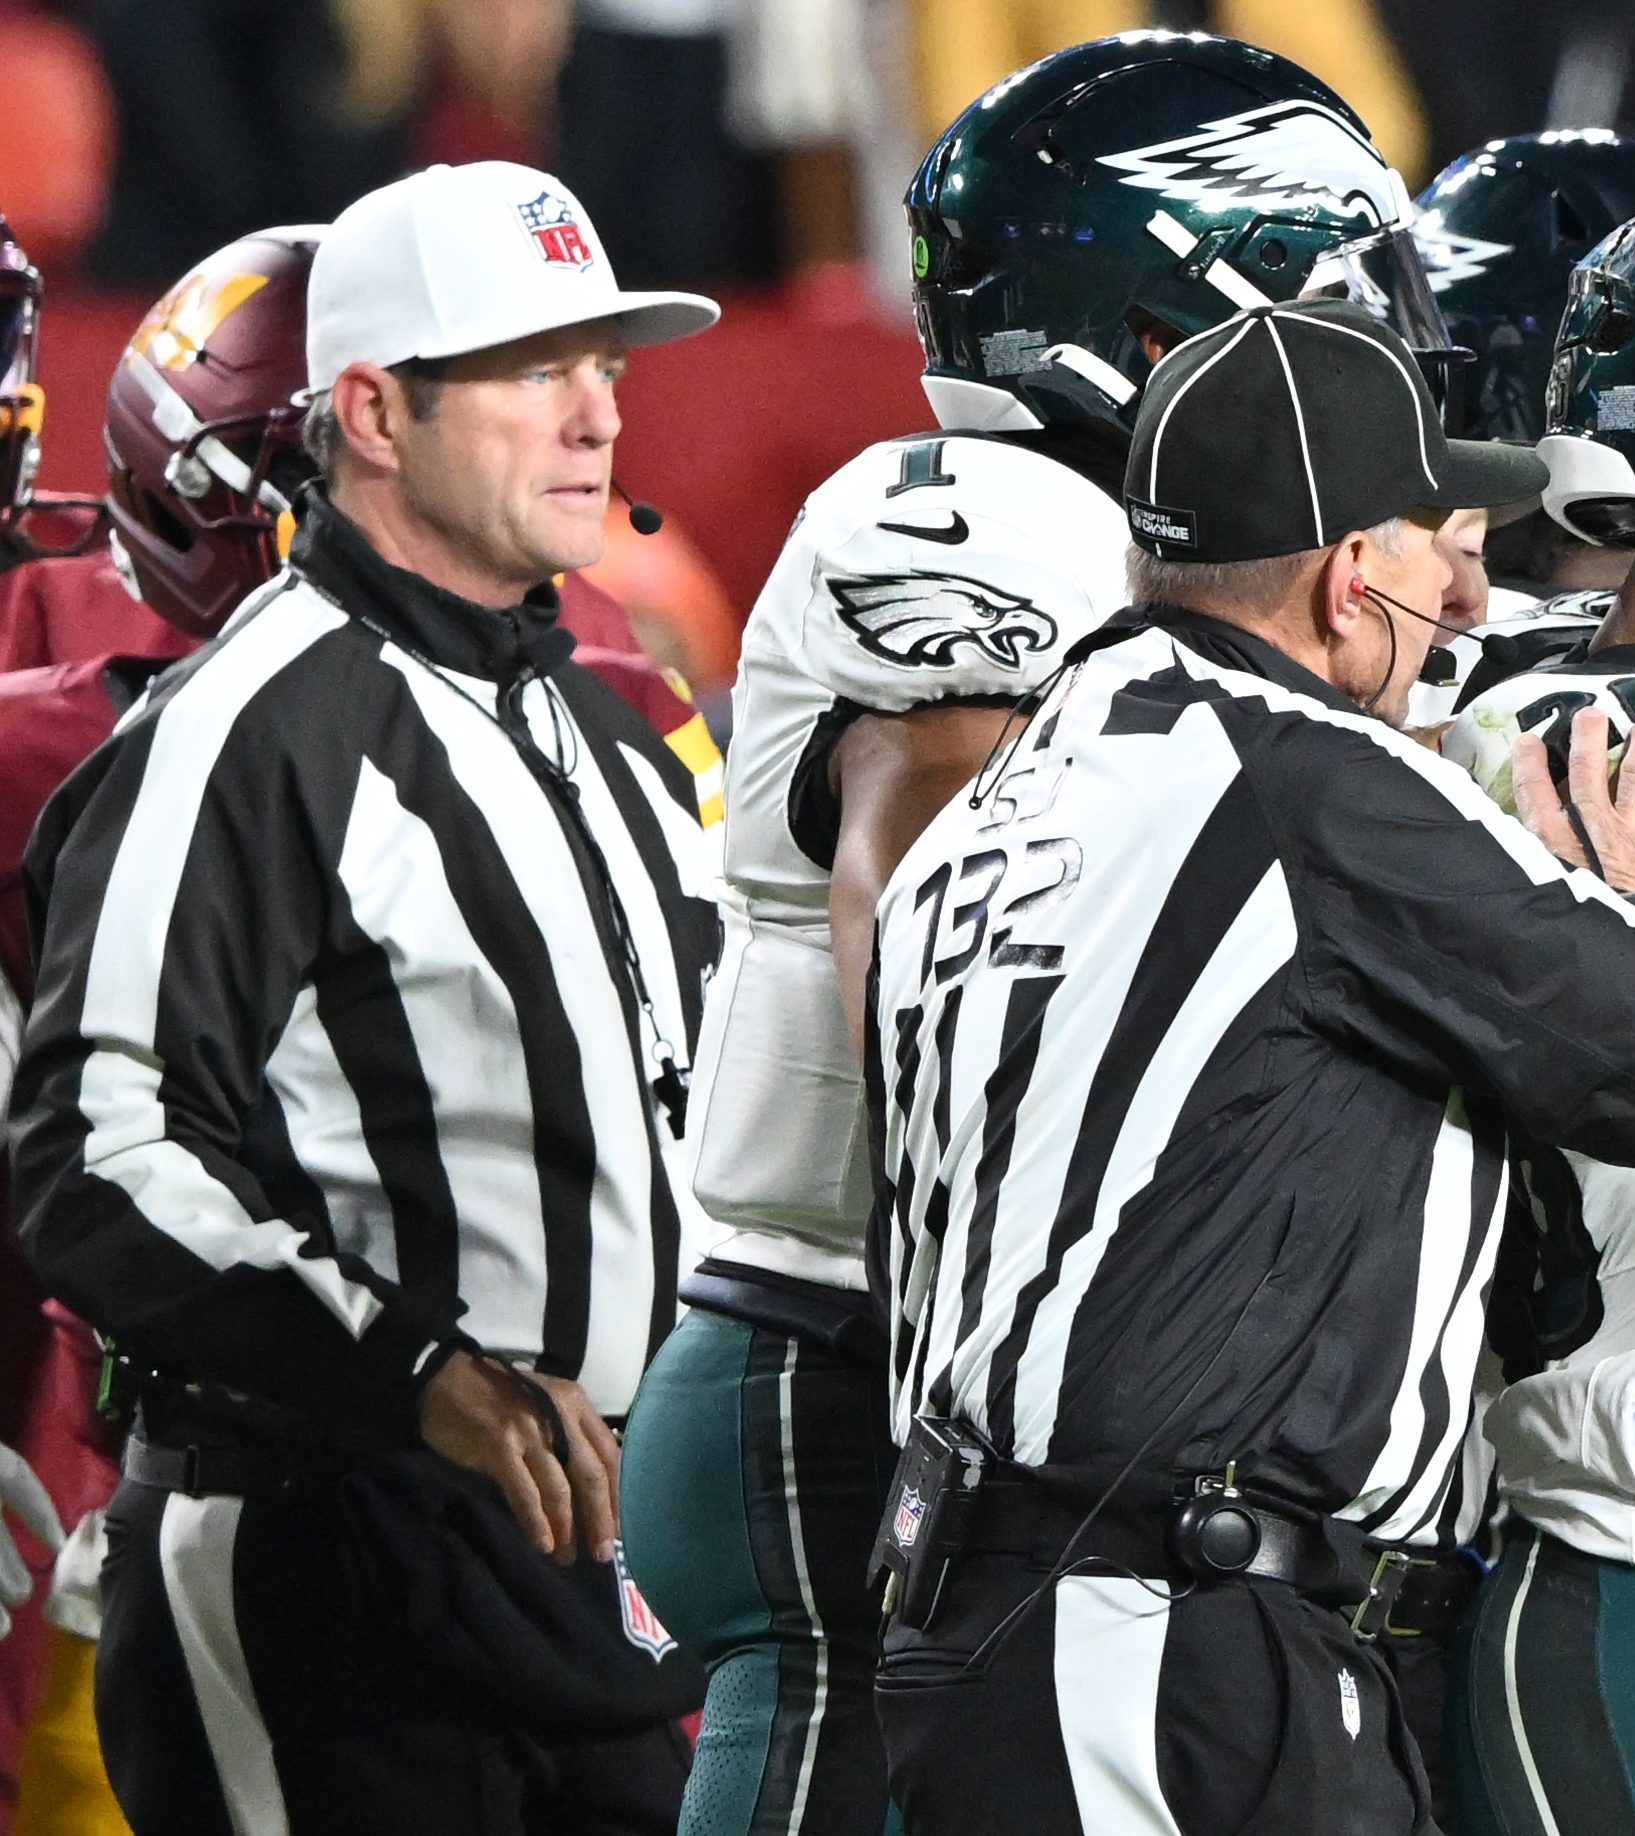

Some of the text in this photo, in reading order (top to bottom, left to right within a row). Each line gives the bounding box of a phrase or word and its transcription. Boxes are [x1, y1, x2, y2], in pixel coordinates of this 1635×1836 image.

[885, 440, 956, 499] 1
[913, 836, 1084, 995] 132
[897, 1508, 918, 1540] NFL
